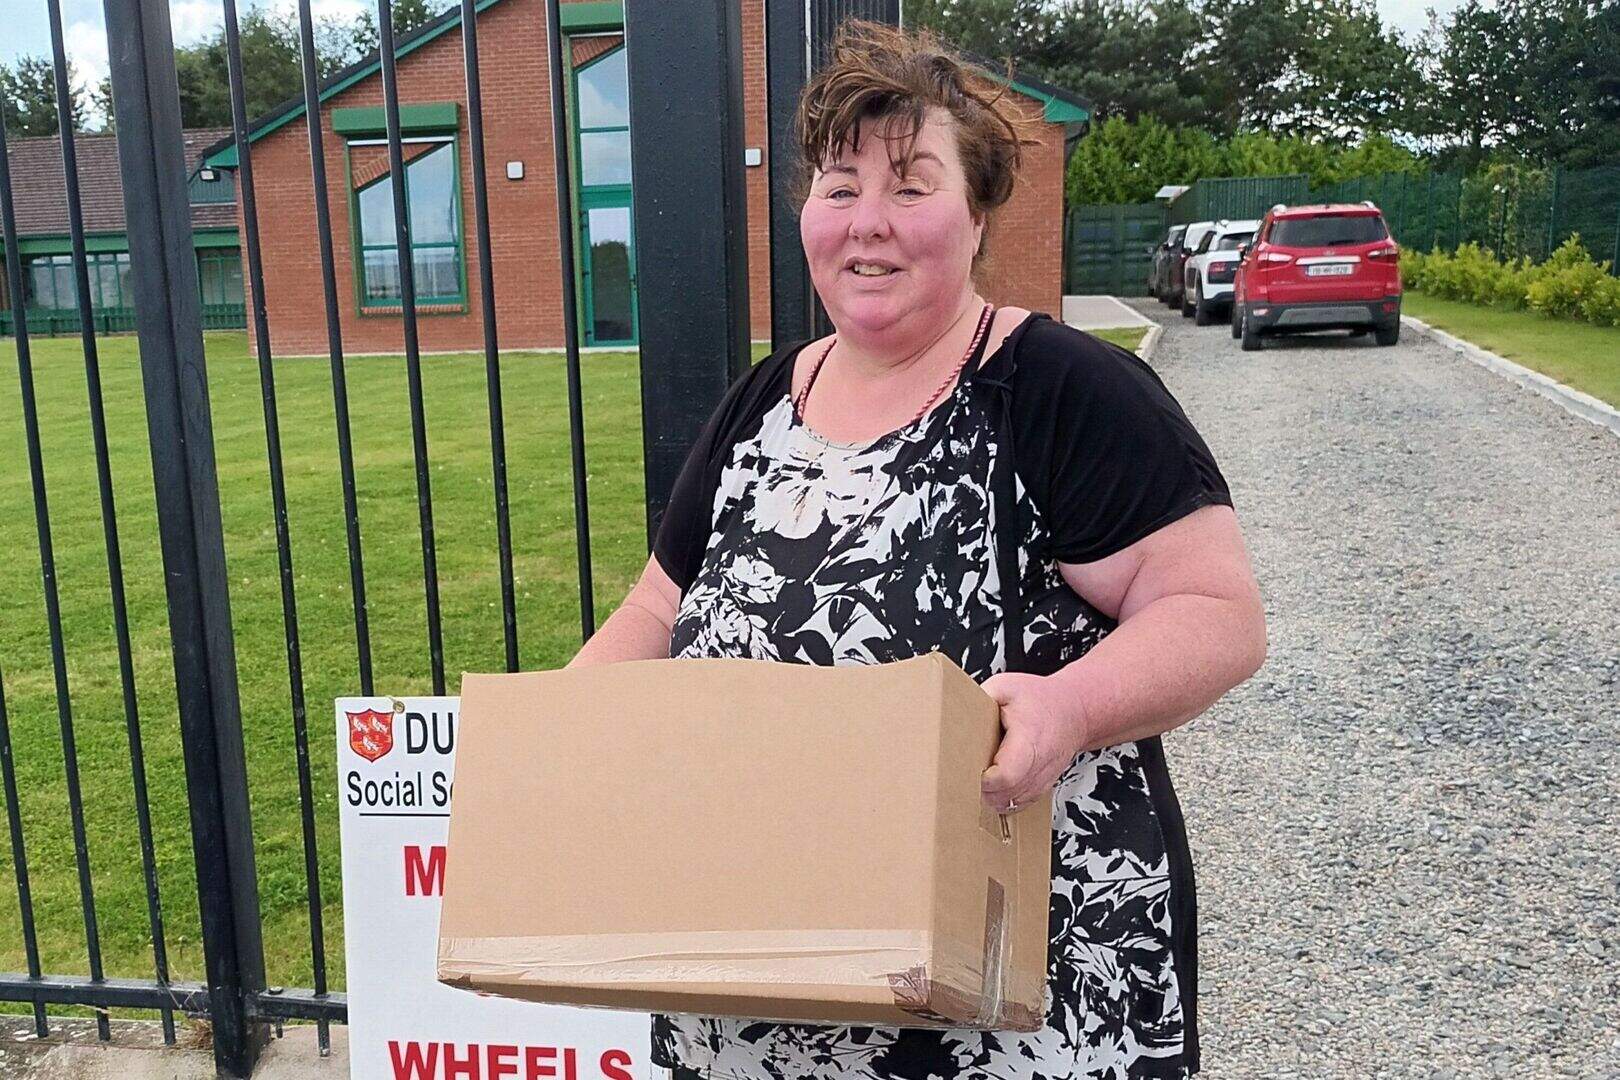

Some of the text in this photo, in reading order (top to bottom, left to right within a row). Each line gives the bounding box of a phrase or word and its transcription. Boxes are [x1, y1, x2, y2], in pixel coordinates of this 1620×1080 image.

[405, 712, 459, 754] DU
[347, 770, 453, 807] Social S
[387, 1040, 634, 1080] WHEELS
